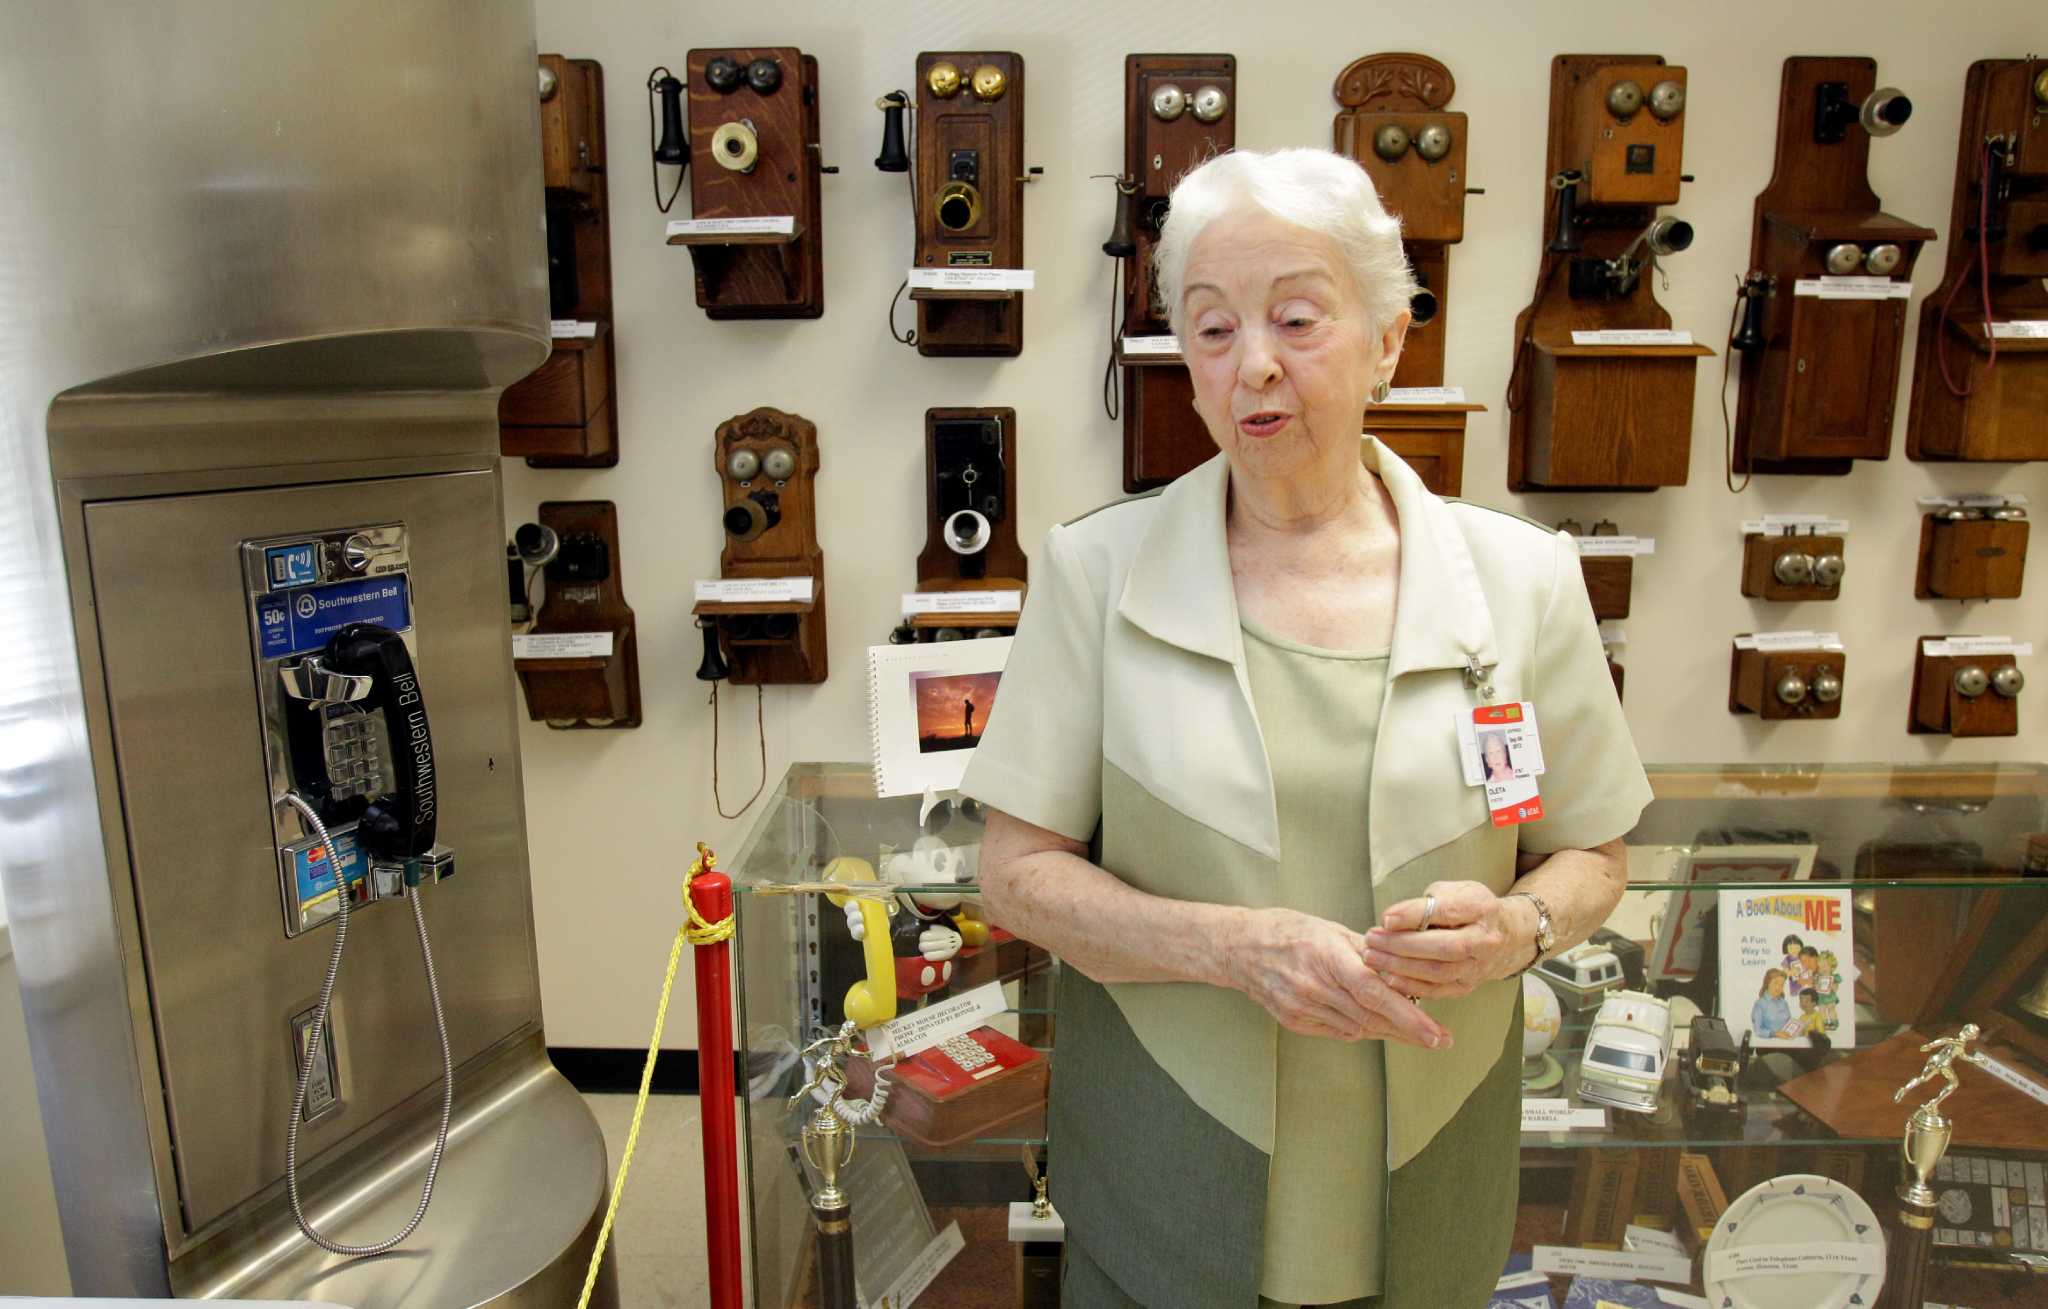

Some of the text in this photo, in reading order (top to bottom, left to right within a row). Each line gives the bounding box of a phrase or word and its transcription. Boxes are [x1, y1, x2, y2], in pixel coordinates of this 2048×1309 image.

[318, 586, 398, 610] Southwestern Bell
[393, 672, 434, 825] Southwestern Bell
[1736, 897, 1842, 932] A Book About ME
[1741, 936, 1767, 944] A Fun
[1741, 947, 1759, 956] Way
[1742, 958, 1766, 966] Learn
